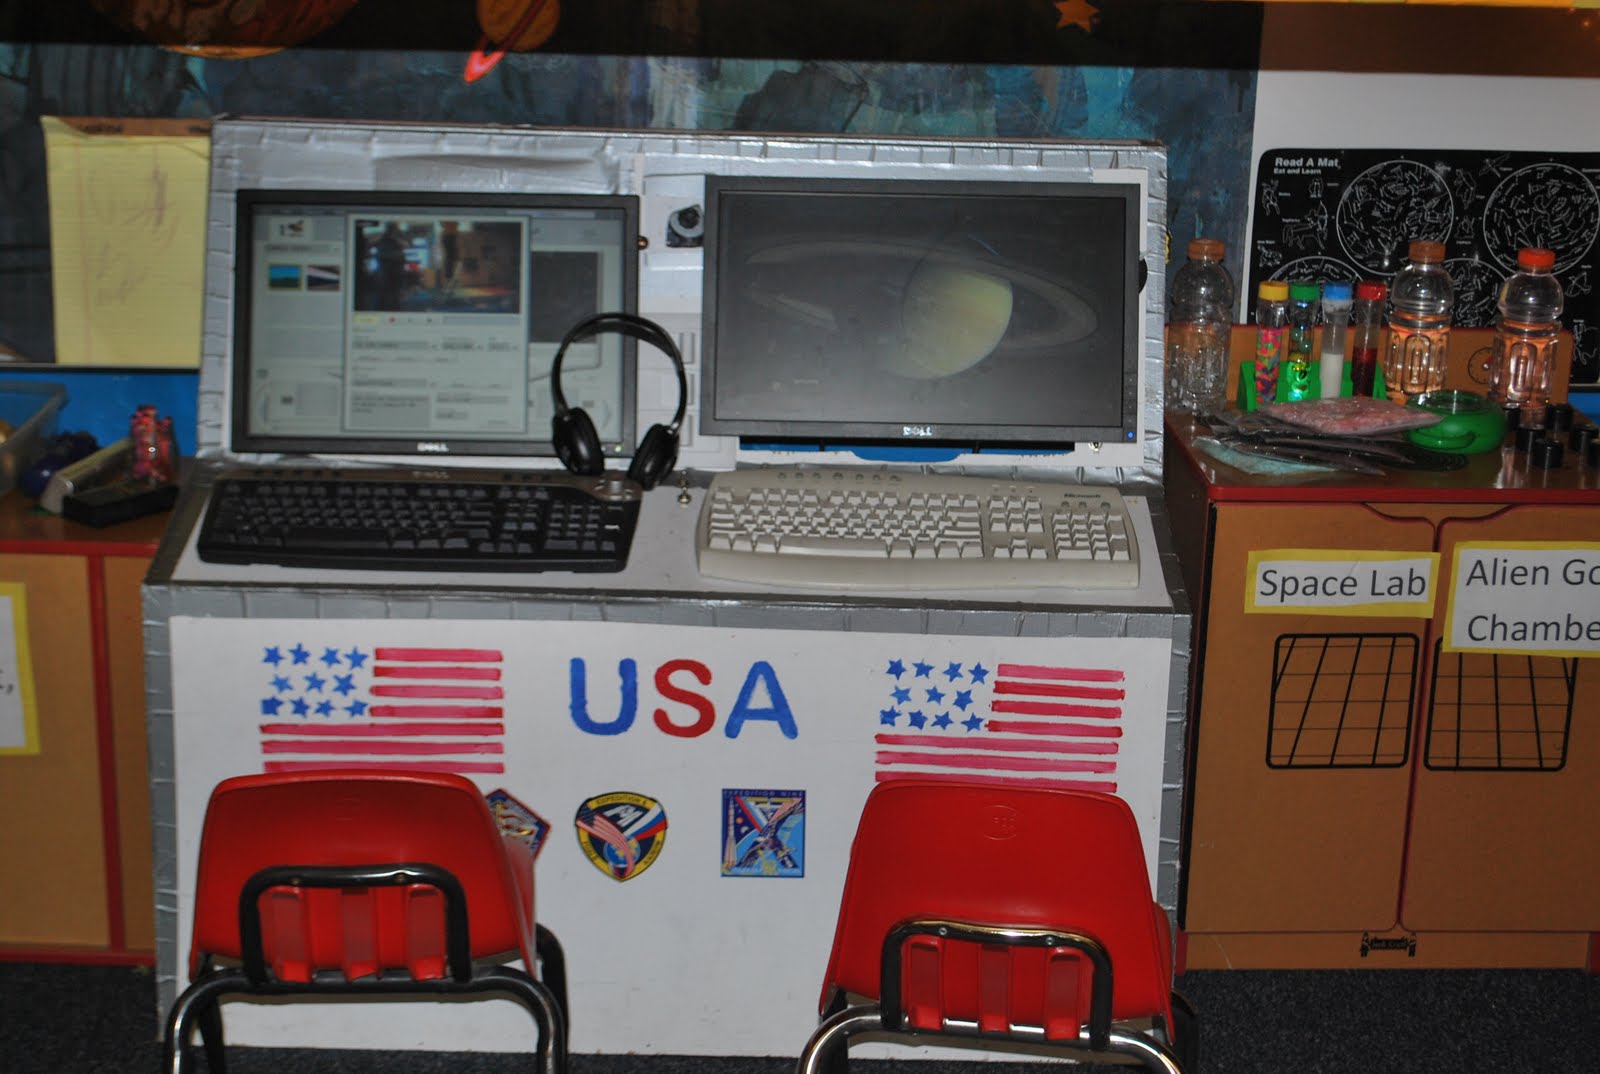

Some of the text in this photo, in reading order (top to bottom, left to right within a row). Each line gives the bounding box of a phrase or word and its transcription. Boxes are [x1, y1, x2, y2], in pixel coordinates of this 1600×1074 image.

[1275, 157, 1339, 167] Read A Mat
[902, 426, 933, 437] DELL
[1260, 568, 1427, 602] Space Lab
[1465, 557, 1550, 586] Alien
[1468, 613, 1600, 641] Chambe
[569, 657, 799, 740] USA
